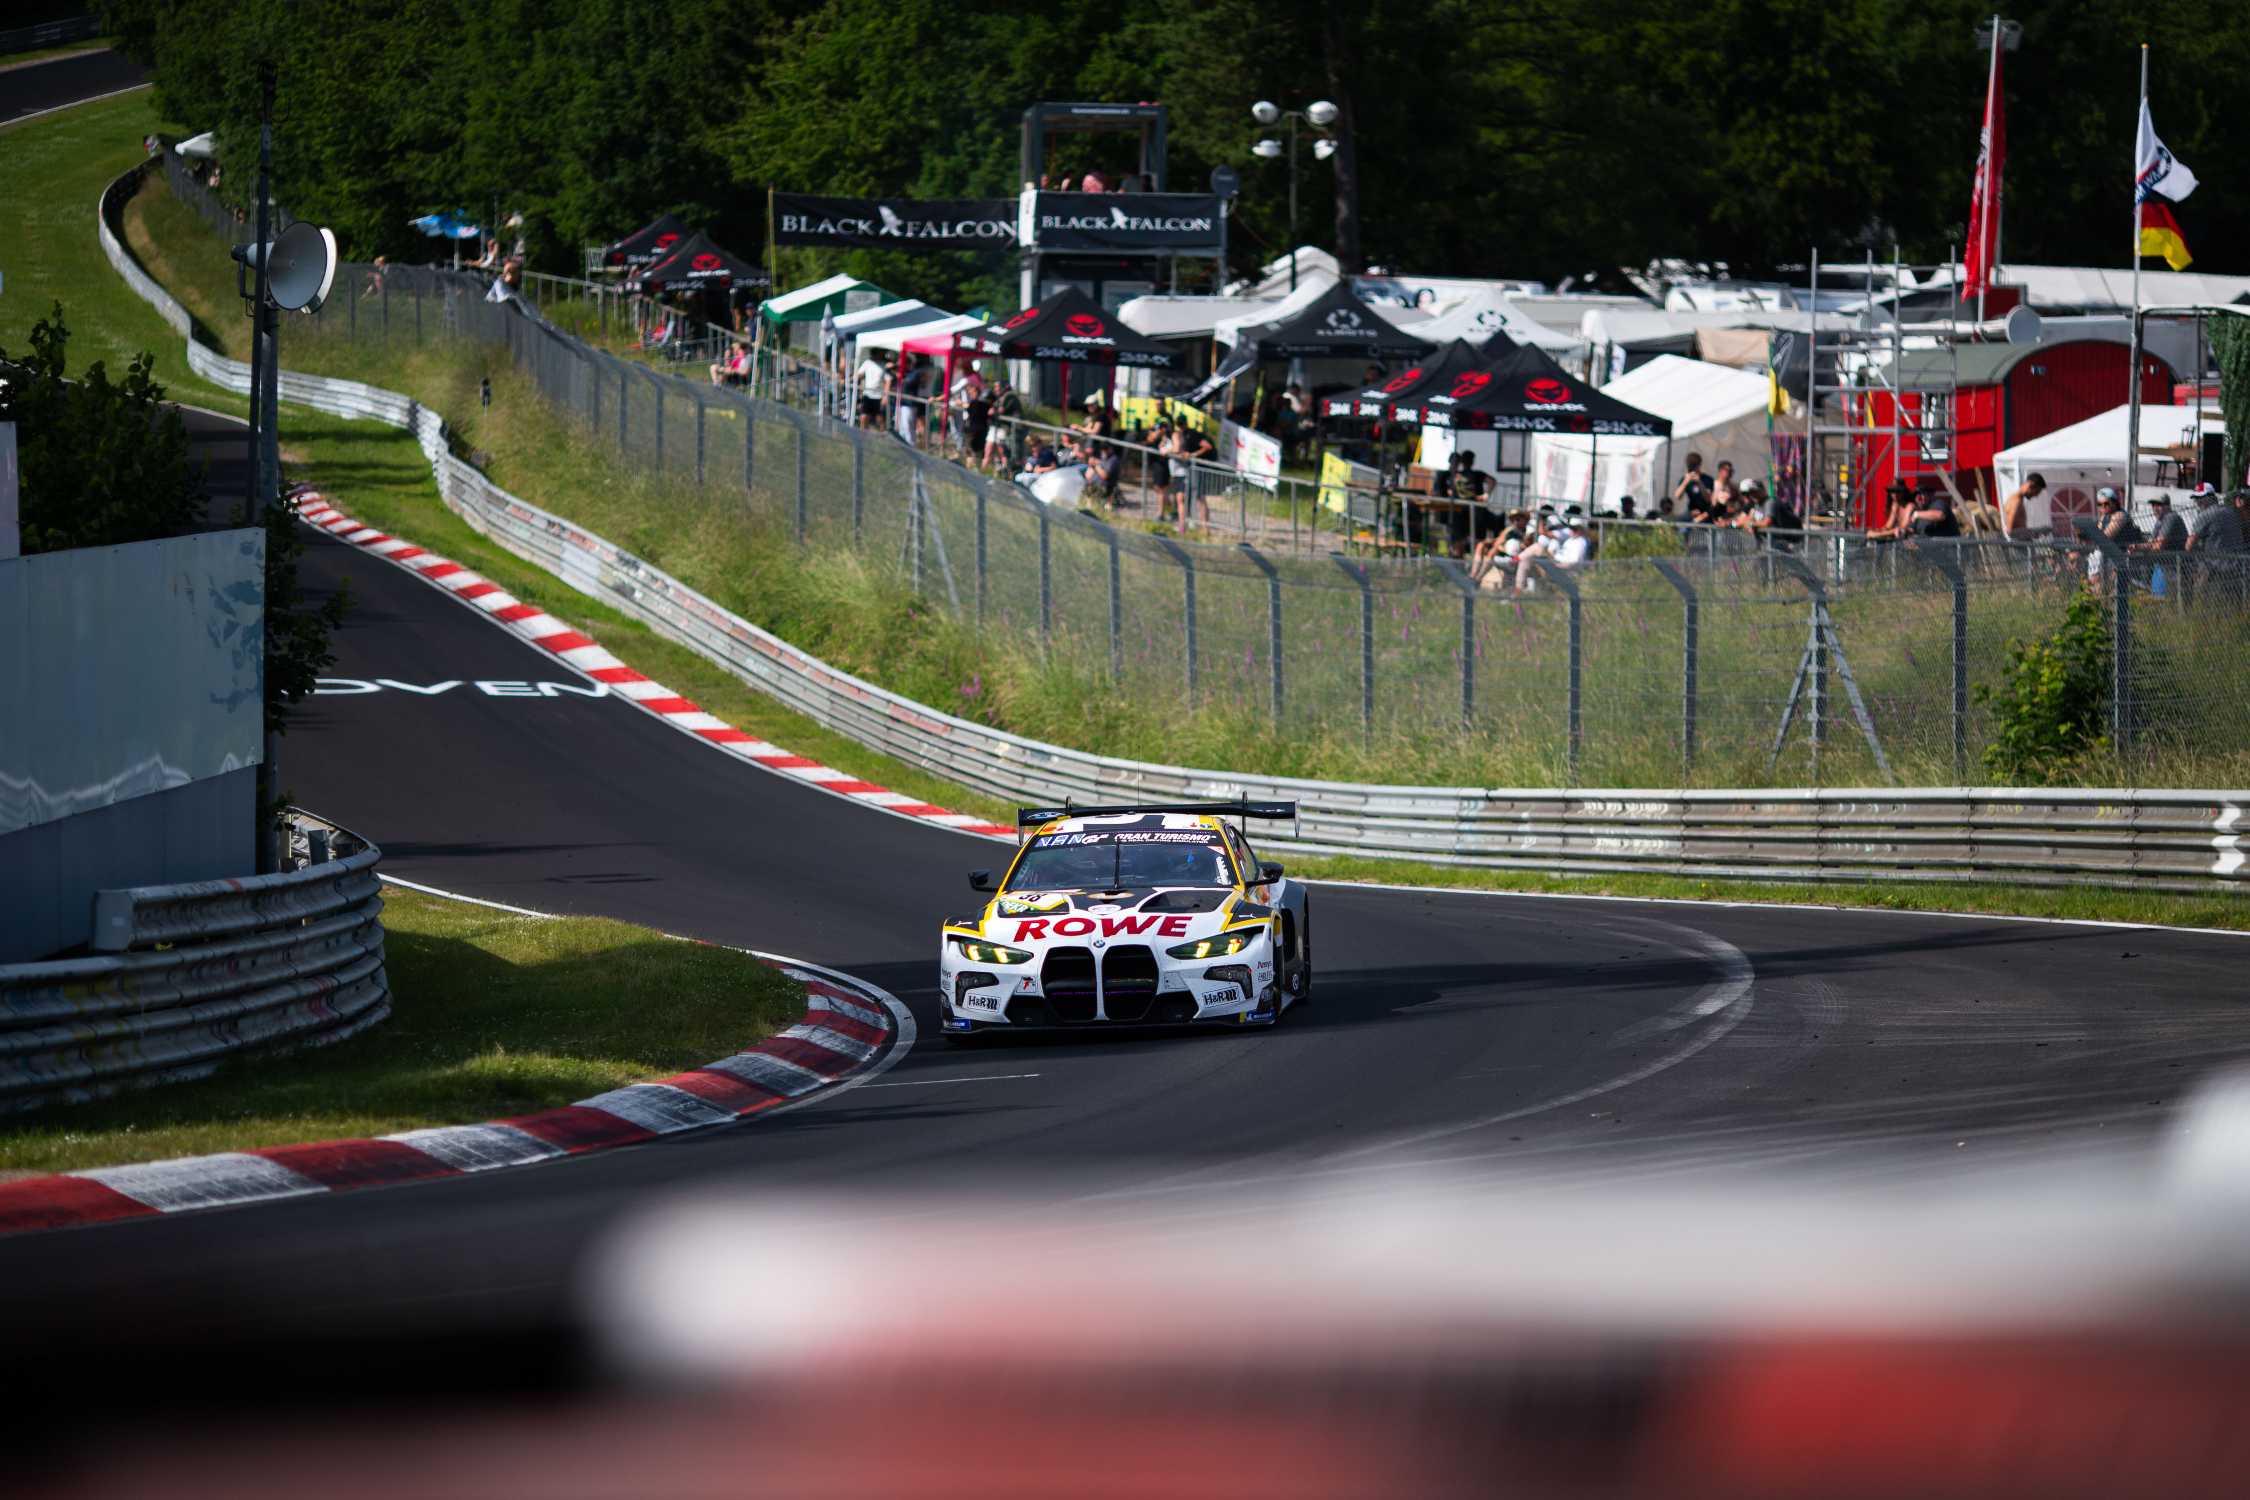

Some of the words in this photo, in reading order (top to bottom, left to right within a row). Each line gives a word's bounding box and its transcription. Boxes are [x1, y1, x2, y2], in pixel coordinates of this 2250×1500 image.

[782, 214, 875, 236] BLACK
[905, 220, 1018, 240] FALCON
[1041, 215, 1108, 230] BLACK
[1129, 216, 1212, 232] FALCON
[1153, 833, 1211, 841] TURISMO
[1013, 916, 1193, 942] ROWE
